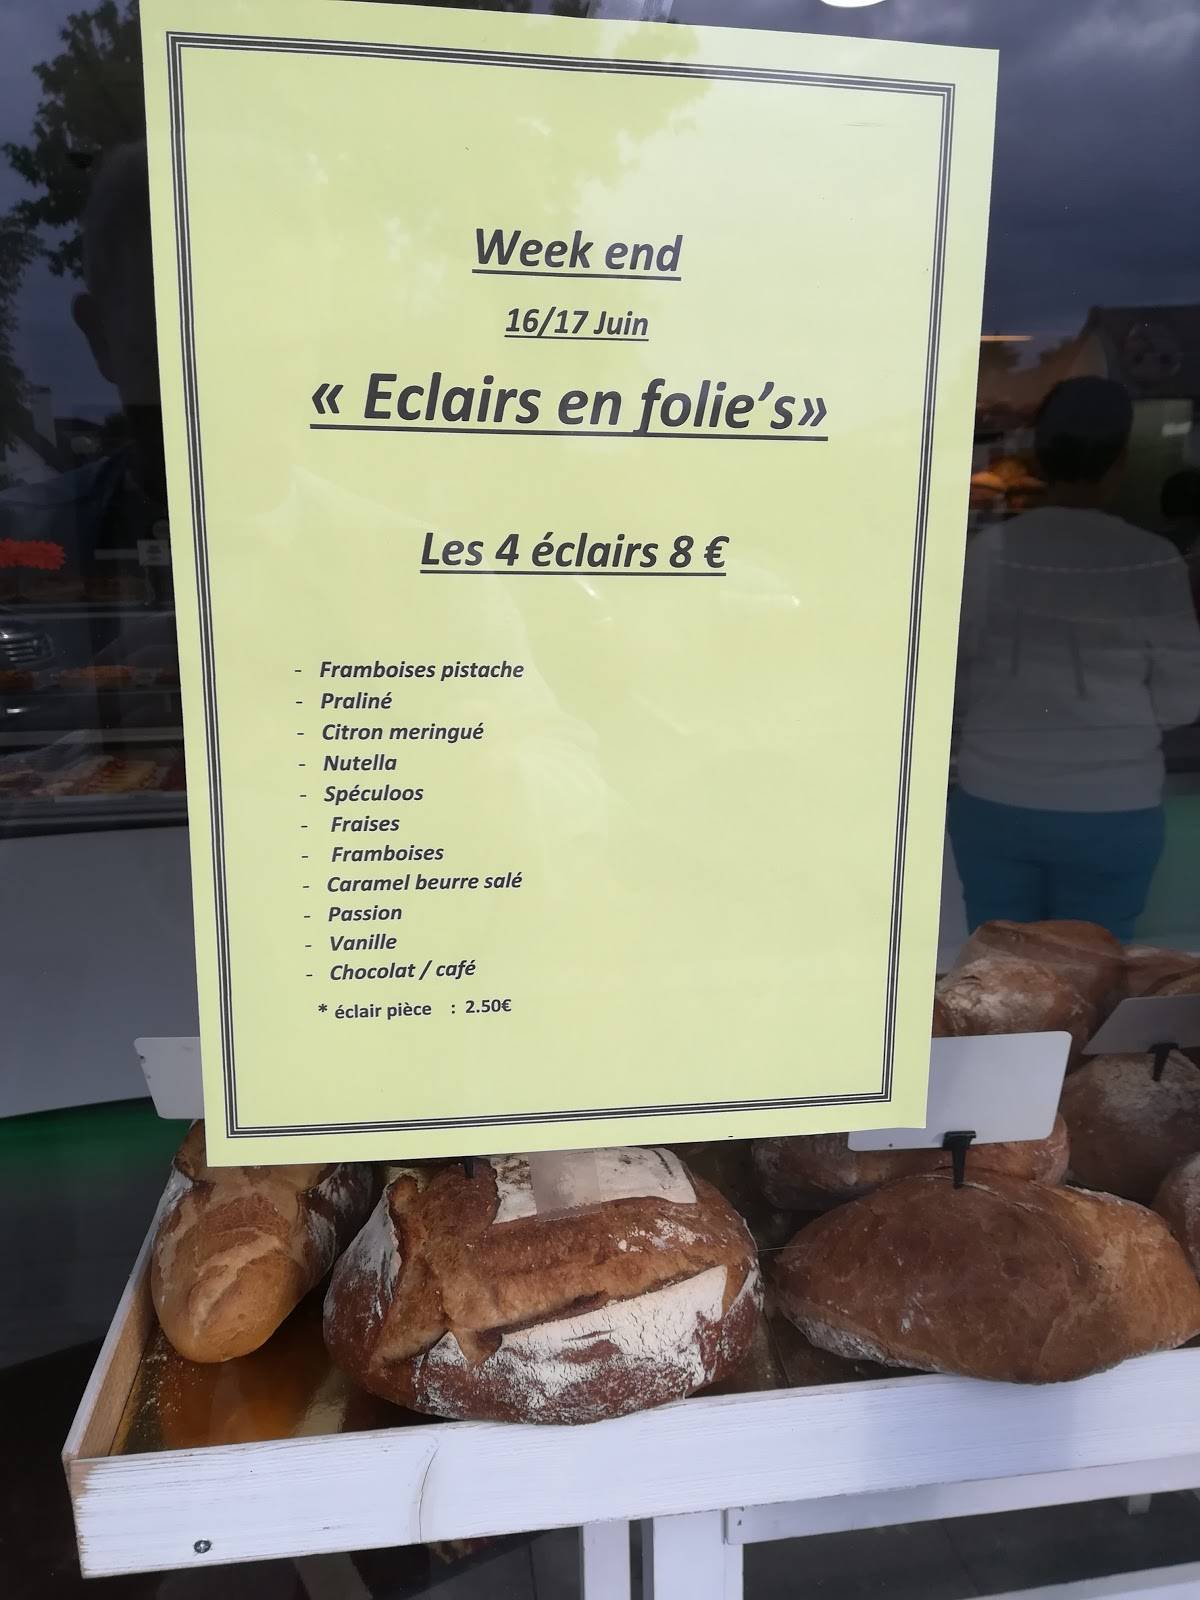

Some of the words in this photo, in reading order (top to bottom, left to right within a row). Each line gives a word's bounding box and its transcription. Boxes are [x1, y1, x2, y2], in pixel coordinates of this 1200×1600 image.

[474, 228, 593, 268] Week
[605, 235, 683, 272] end
[505, 307, 589, 335] 16/17
[593, 311, 649, 336] Juin
[364, 372, 541, 425] Eclairs
[558, 390, 621, 425] en
[421, 532, 483, 566] Les
[495, 533, 519, 566] 4
[532, 532, 658, 568] éclairs
[669, 535, 694, 568] 8
[704, 535, 729, 568] €
[320, 661, 436, 678] Framboises
[440, 661, 524, 681] pistache
[320, 692, 393, 709] Praliné
[322, 723, 383, 740] Citron
[389, 722, 484, 743] meringué
[323, 754, 397, 771] Nutella
[324, 784, 424, 805] Spéculoos
[331, 815, 400, 832] Fraises
[331, 844, 444, 862] Framboises
[327, 874, 410, 892] Caramel
[415, 874, 479, 890] beurre
[484, 872, 522, 889] salé
[328, 905, 402, 922] Passion
[330, 933, 397, 951] Vanille
[330, 963, 415, 980] Chocolat
[436, 959, 476, 980] café
[335, 1004, 382, 1019] éclair
[387, 1002, 432, 1020] pièce
[465, 999, 512, 1014] 2.50€
